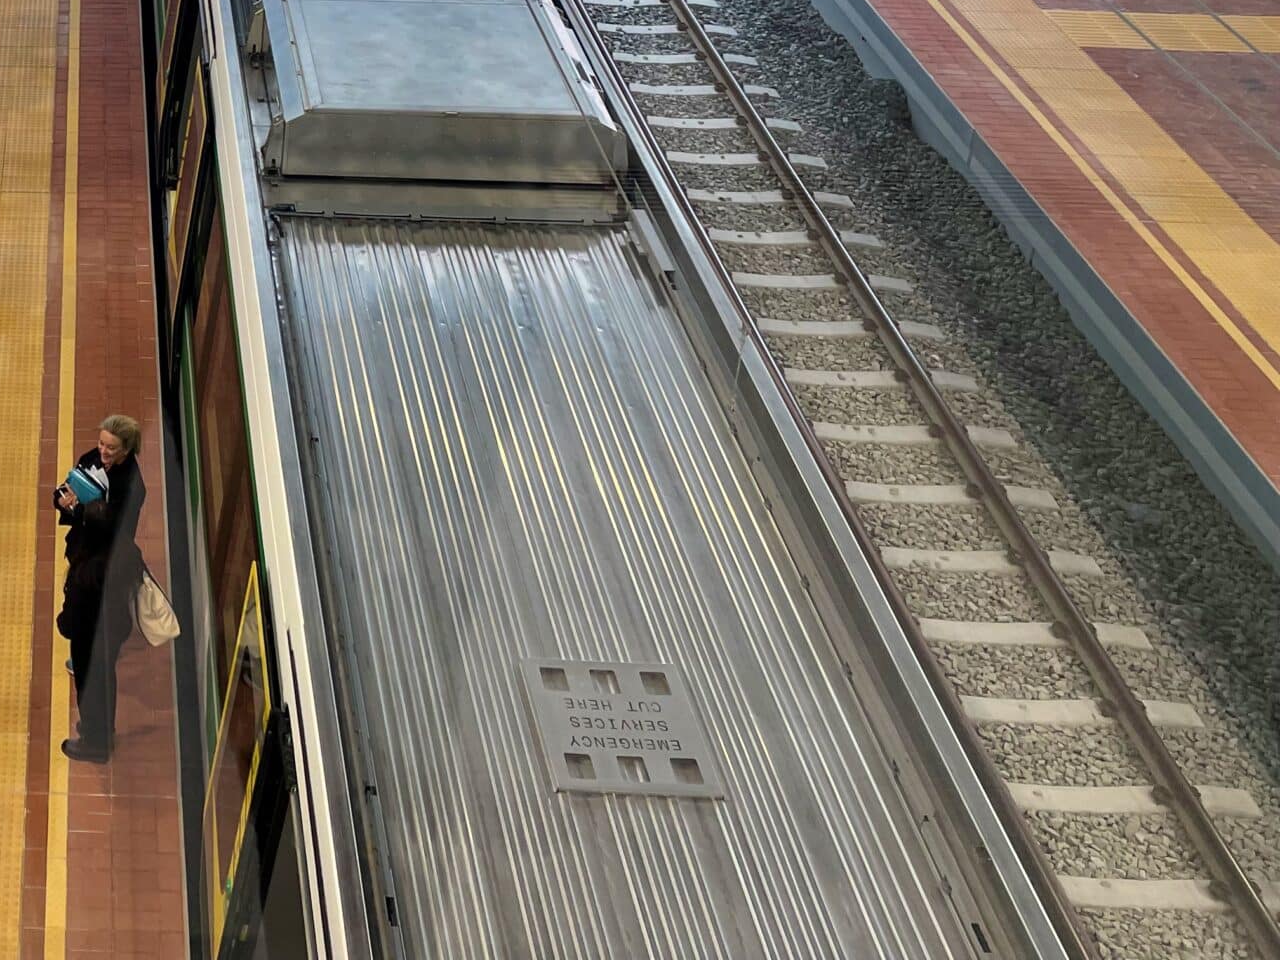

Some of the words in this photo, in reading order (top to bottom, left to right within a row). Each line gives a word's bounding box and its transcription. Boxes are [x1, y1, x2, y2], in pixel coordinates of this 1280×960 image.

[563, 697, 612, 711] HERE
[626, 700, 661, 713] CUT
[569, 716, 669, 732] SERVICES
[570, 735, 682, 751] EMERGENCY
